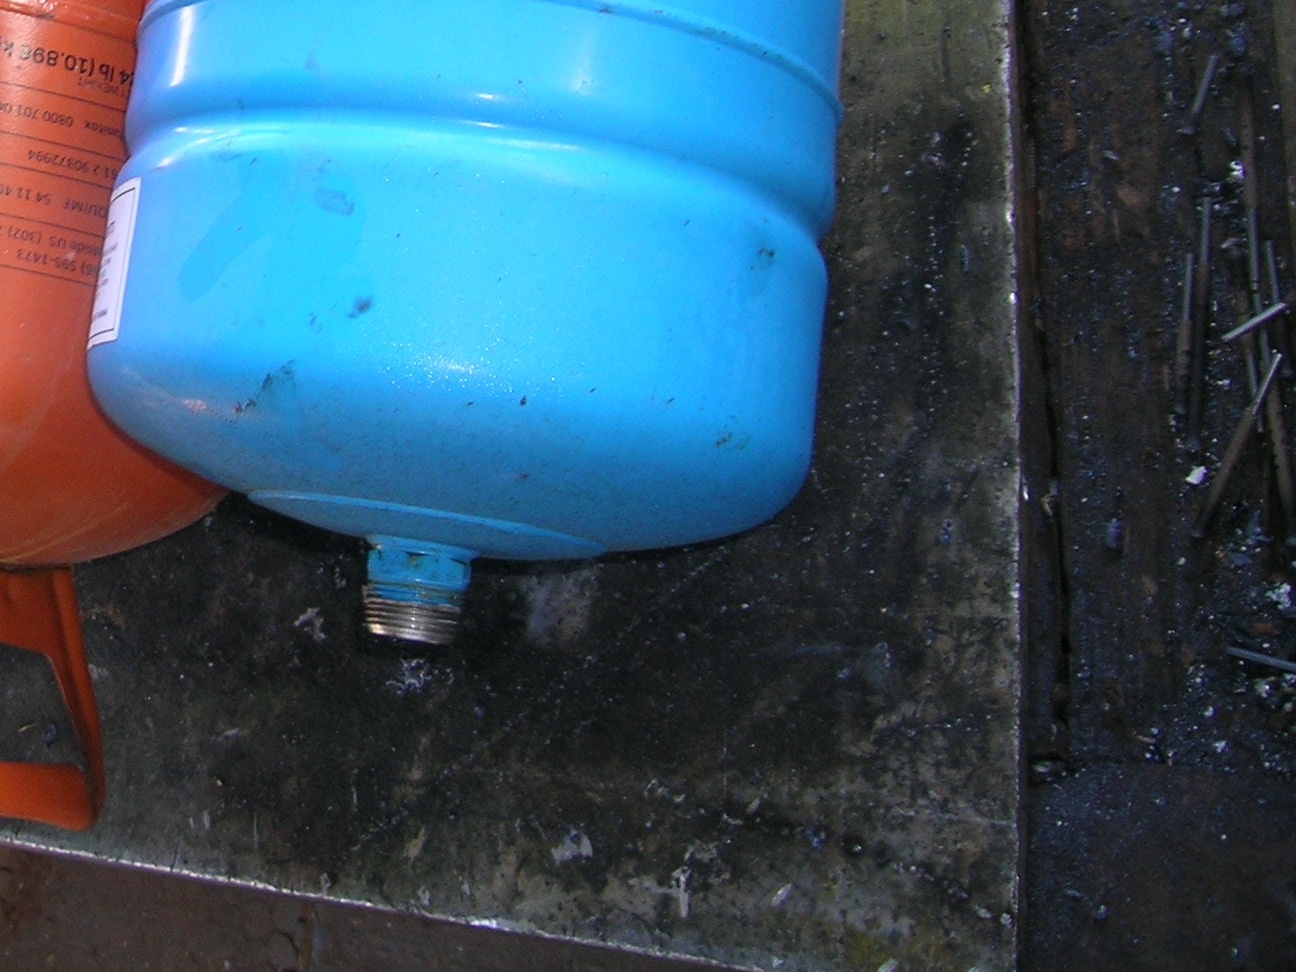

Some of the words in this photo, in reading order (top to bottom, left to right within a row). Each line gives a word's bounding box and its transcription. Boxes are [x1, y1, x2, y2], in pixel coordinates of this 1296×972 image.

[99, 63, 114, 80] lb
[119, 68, 134, 85] 4
[43, 109, 73, 127] 0800
[16, 187, 30, 202] 11
[35, 192, 52, 205] 54
[62, 199, 107, 218] QUIME
[7, 224, 42, 244] (302)
[48, 235, 67, 250] US
